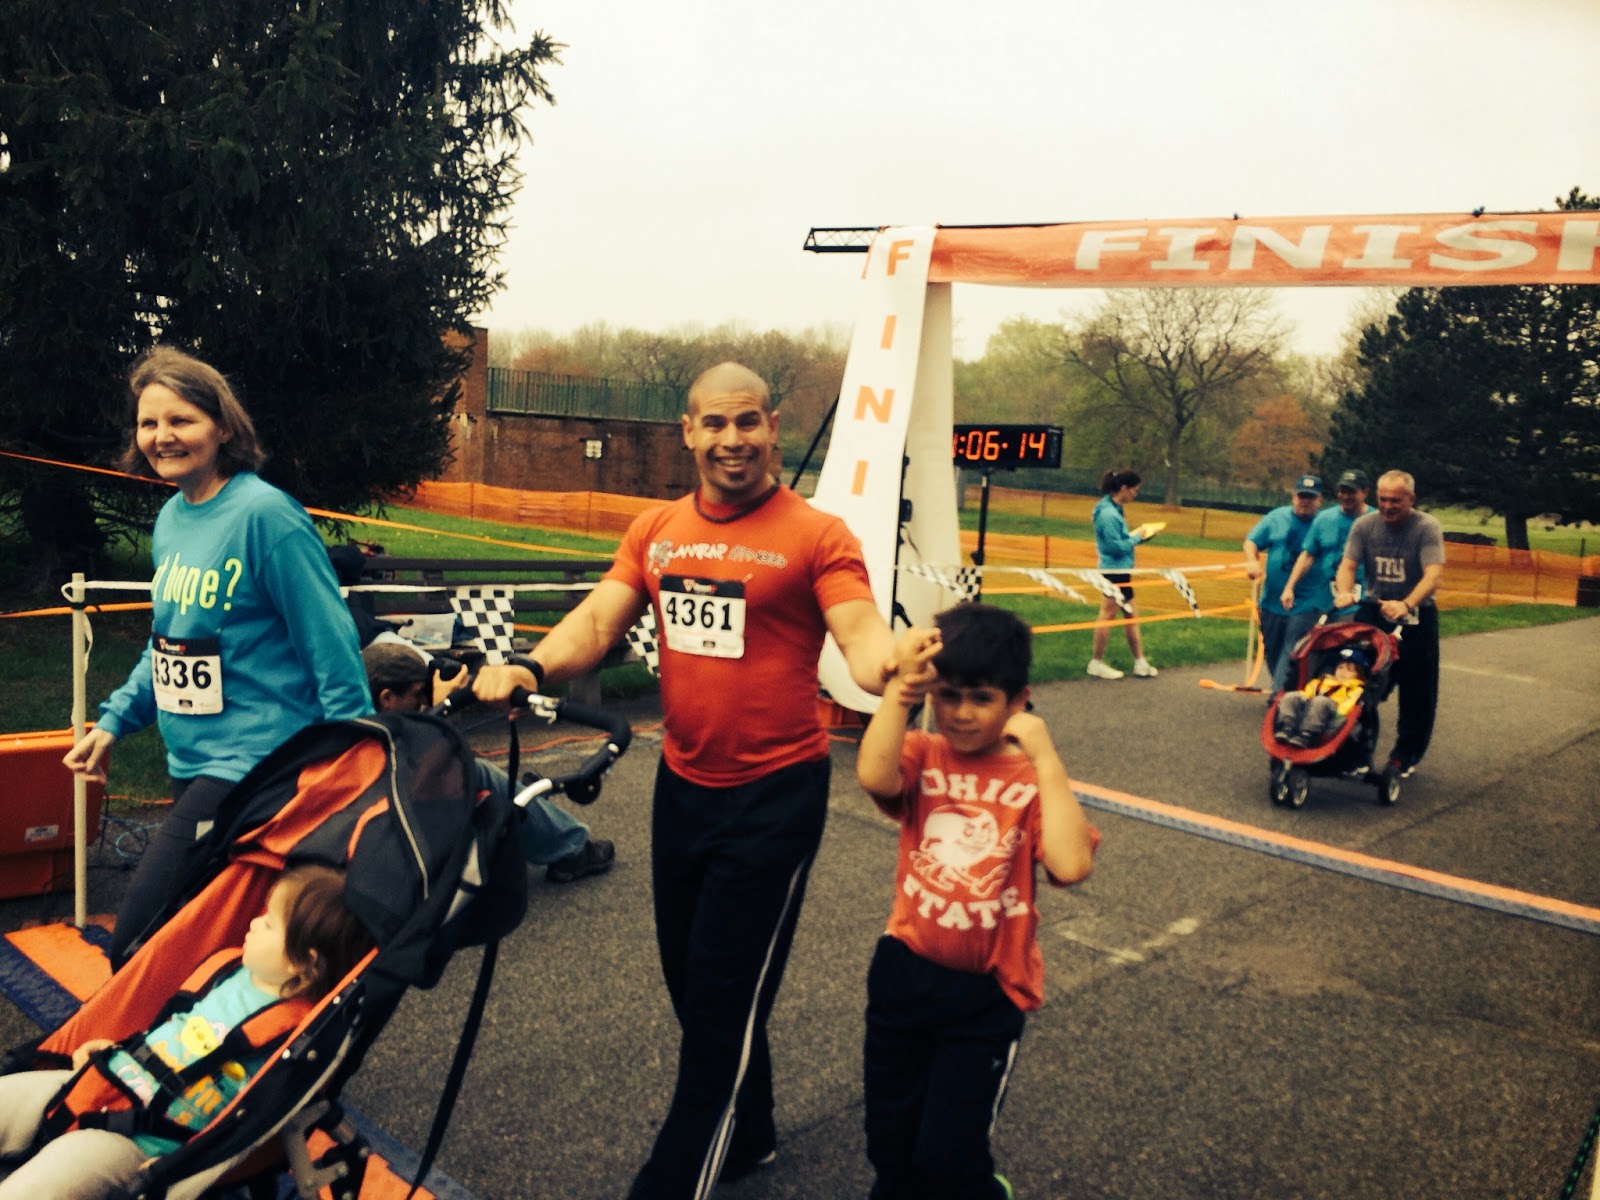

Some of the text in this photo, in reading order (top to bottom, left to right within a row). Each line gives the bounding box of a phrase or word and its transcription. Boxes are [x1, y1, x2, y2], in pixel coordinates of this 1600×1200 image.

[162, 551, 243, 616] hope?
[666, 596, 732, 631] 4361
[920, 767, 1038, 809] OHIO
